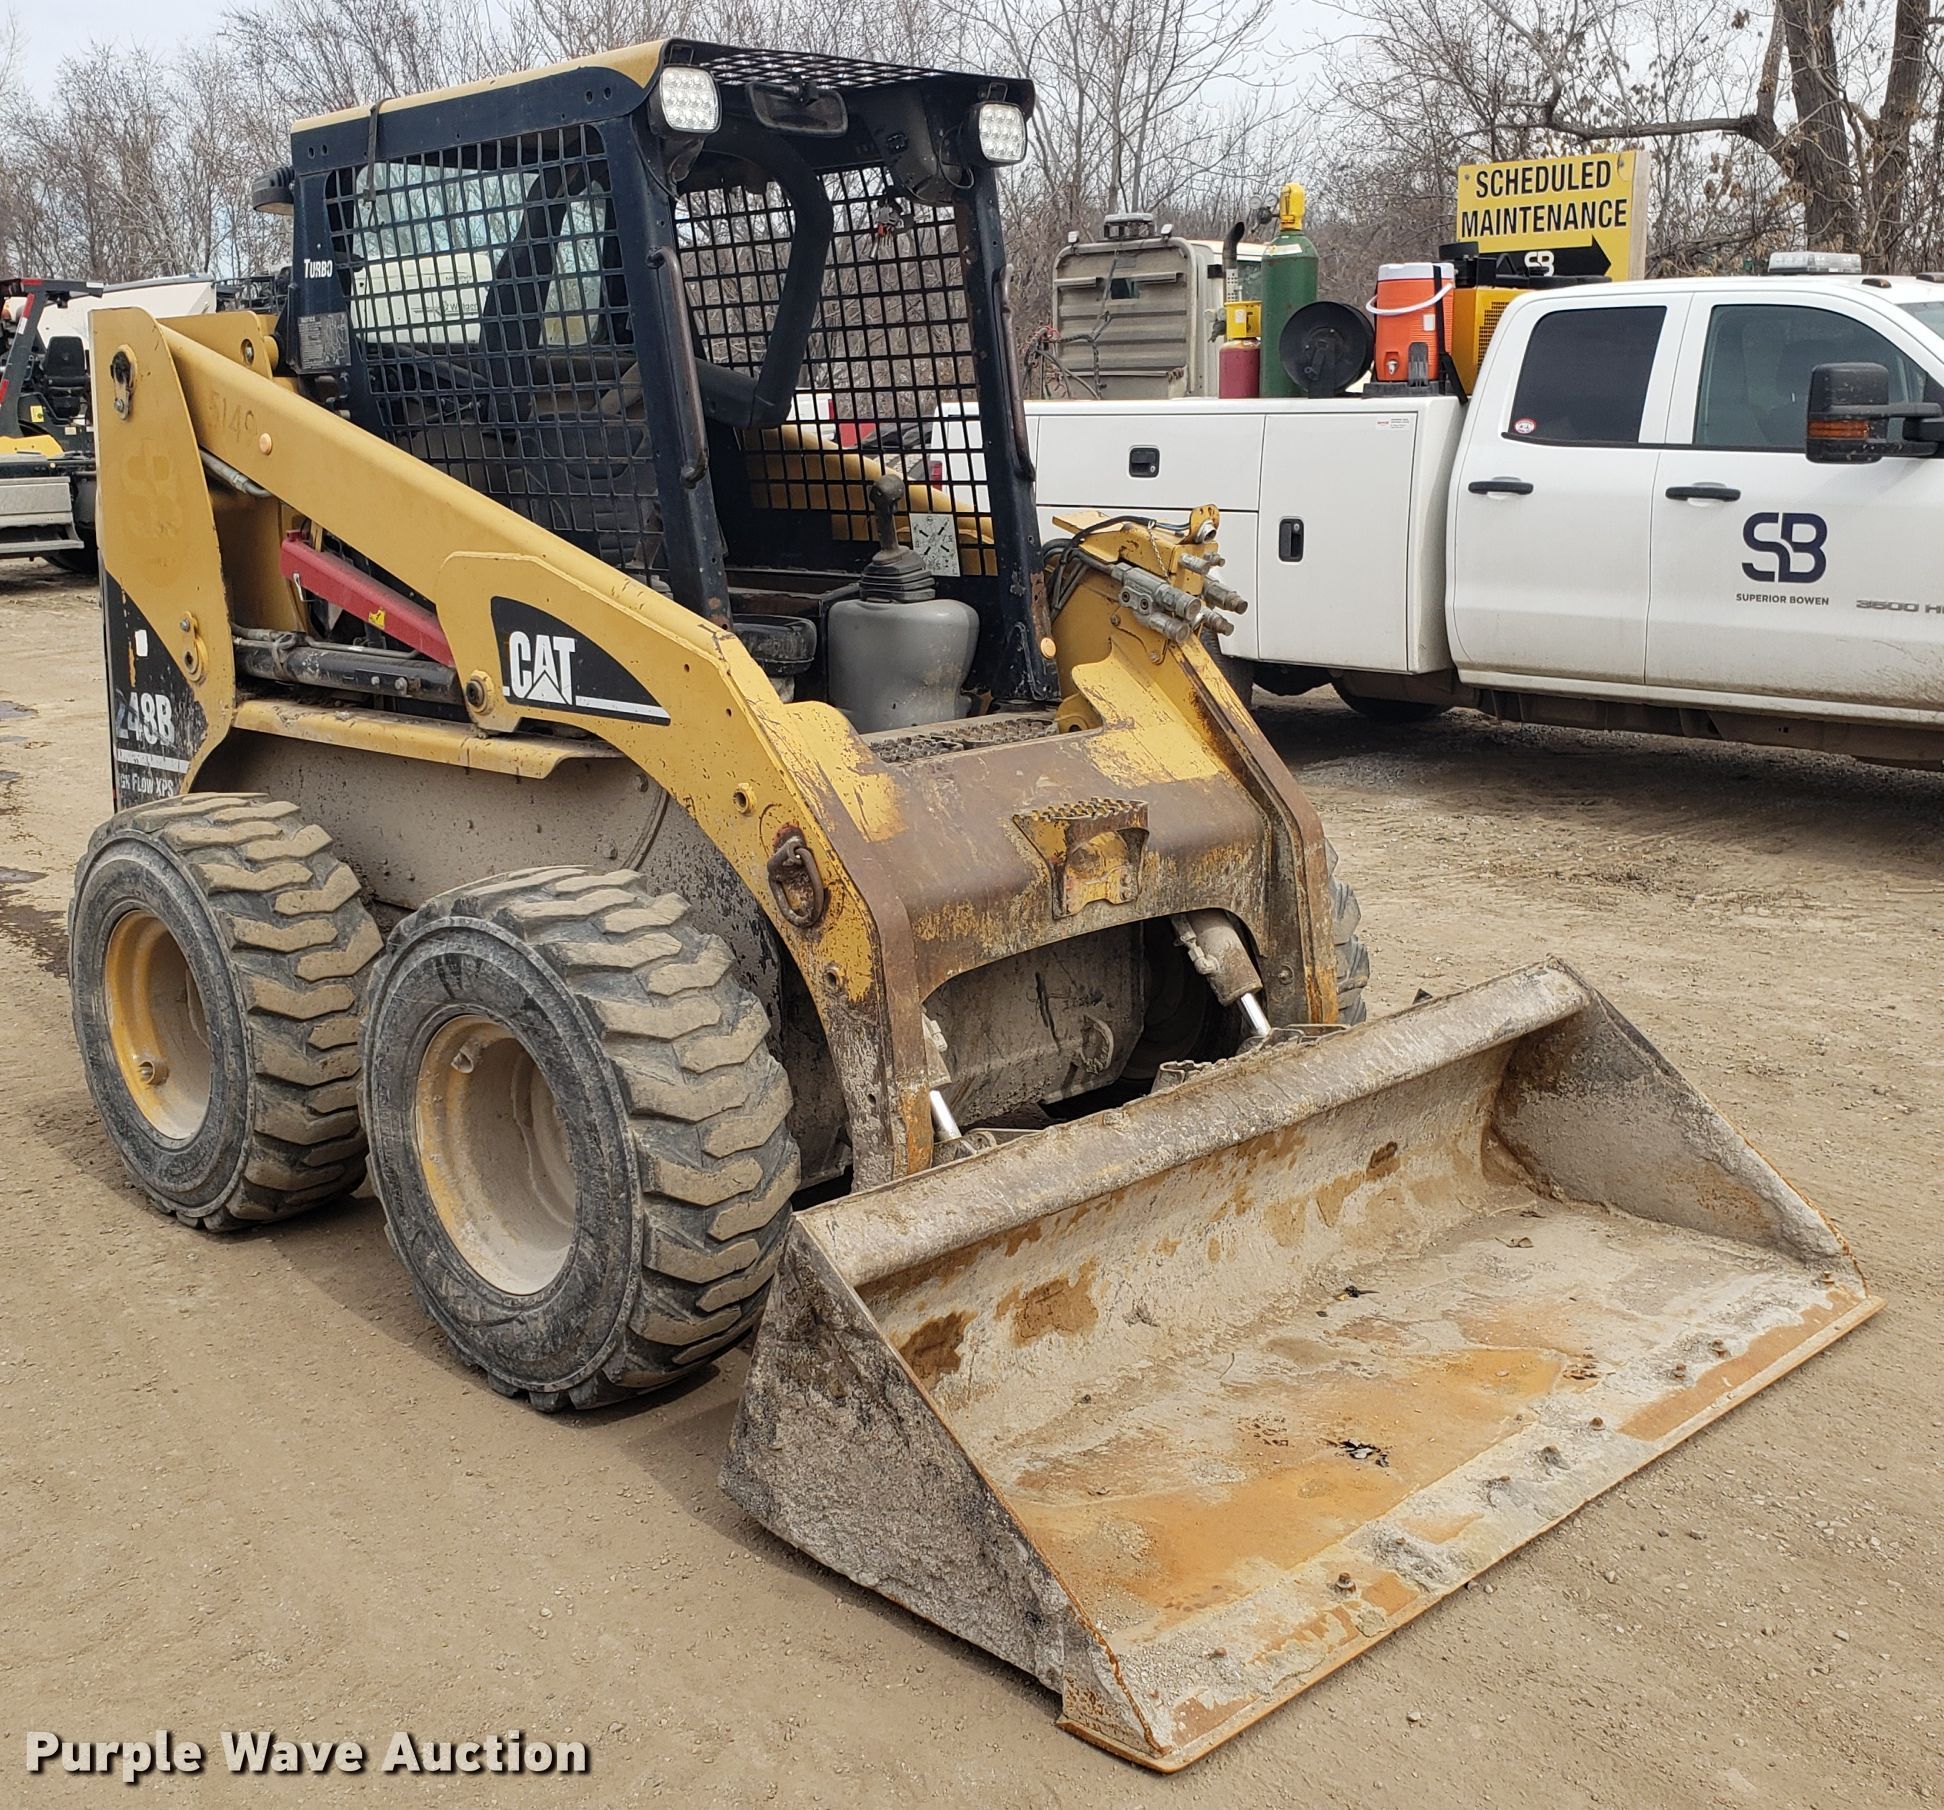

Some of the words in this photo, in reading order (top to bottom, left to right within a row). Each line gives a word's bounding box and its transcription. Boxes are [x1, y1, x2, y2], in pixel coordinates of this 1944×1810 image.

[1475, 160, 1611, 198] SCHEDULED
[1461, 199, 1628, 238] MAINTENANCE
[1741, 512, 1828, 584] SB
[1736, 593, 1787, 604] SUPERIOR
[1789, 595, 1830, 606] BOWEN
[1856, 599, 1920, 613] 3500
[1924, 603, 1944, 615] H
[509, 630, 576, 706] CAT
[131, 772, 154, 795] FLOW
[155, 776, 174, 798] XPS
